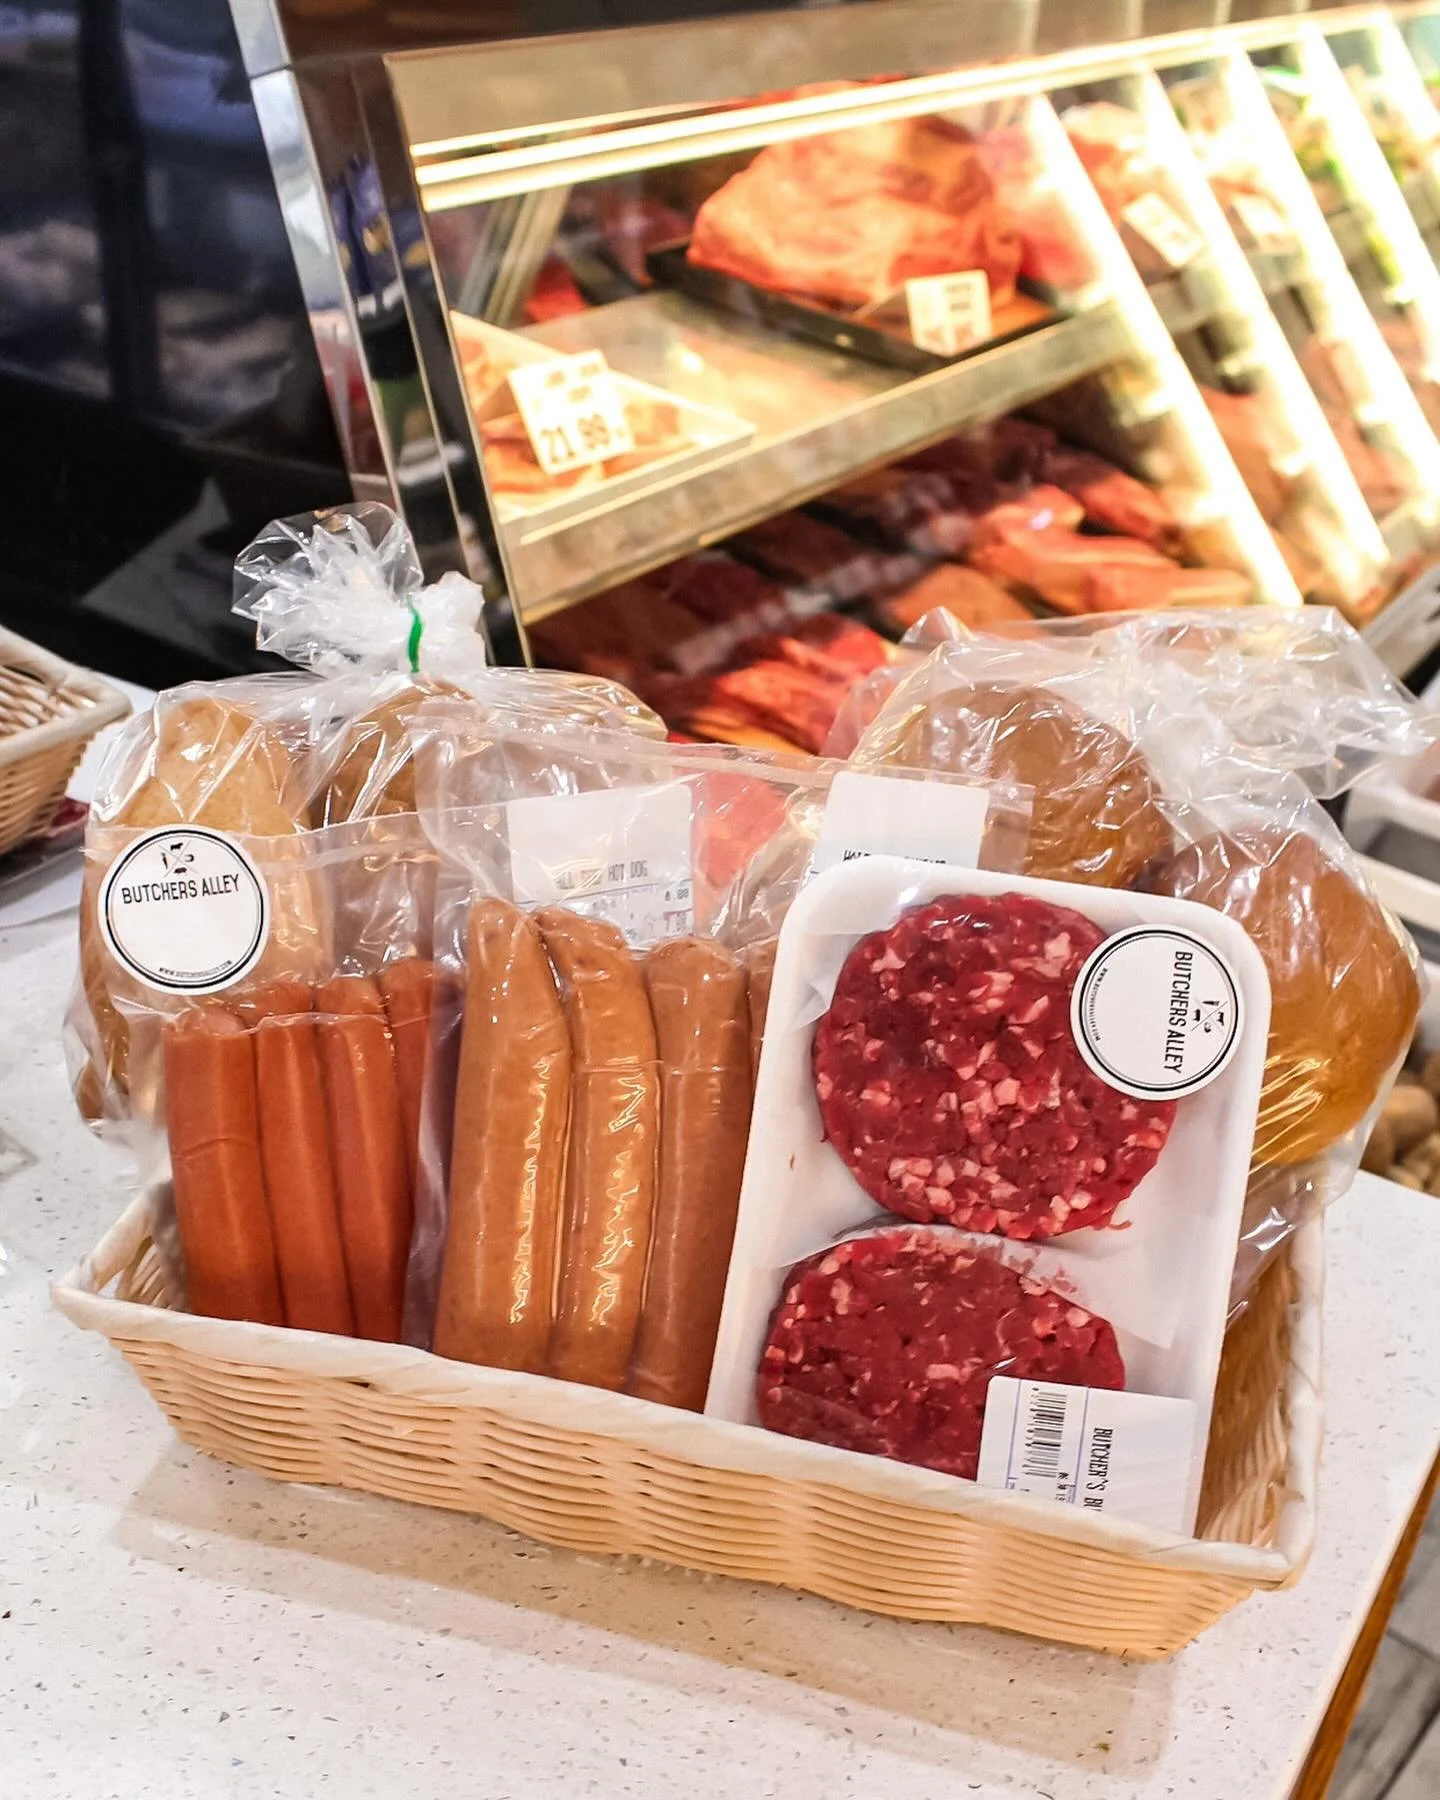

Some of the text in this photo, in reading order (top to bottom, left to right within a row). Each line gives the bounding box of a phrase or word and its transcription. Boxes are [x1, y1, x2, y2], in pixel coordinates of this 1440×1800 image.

[121, 873, 240, 904] BUTCHERS ALLEY
[608, 863, 625, 882] HOT
[630, 860, 648, 878] DOG
[1164, 951, 1193, 1074] BUTCHERS ALLEY
[1085, 1427, 1113, 1492] BUTCHER'S
